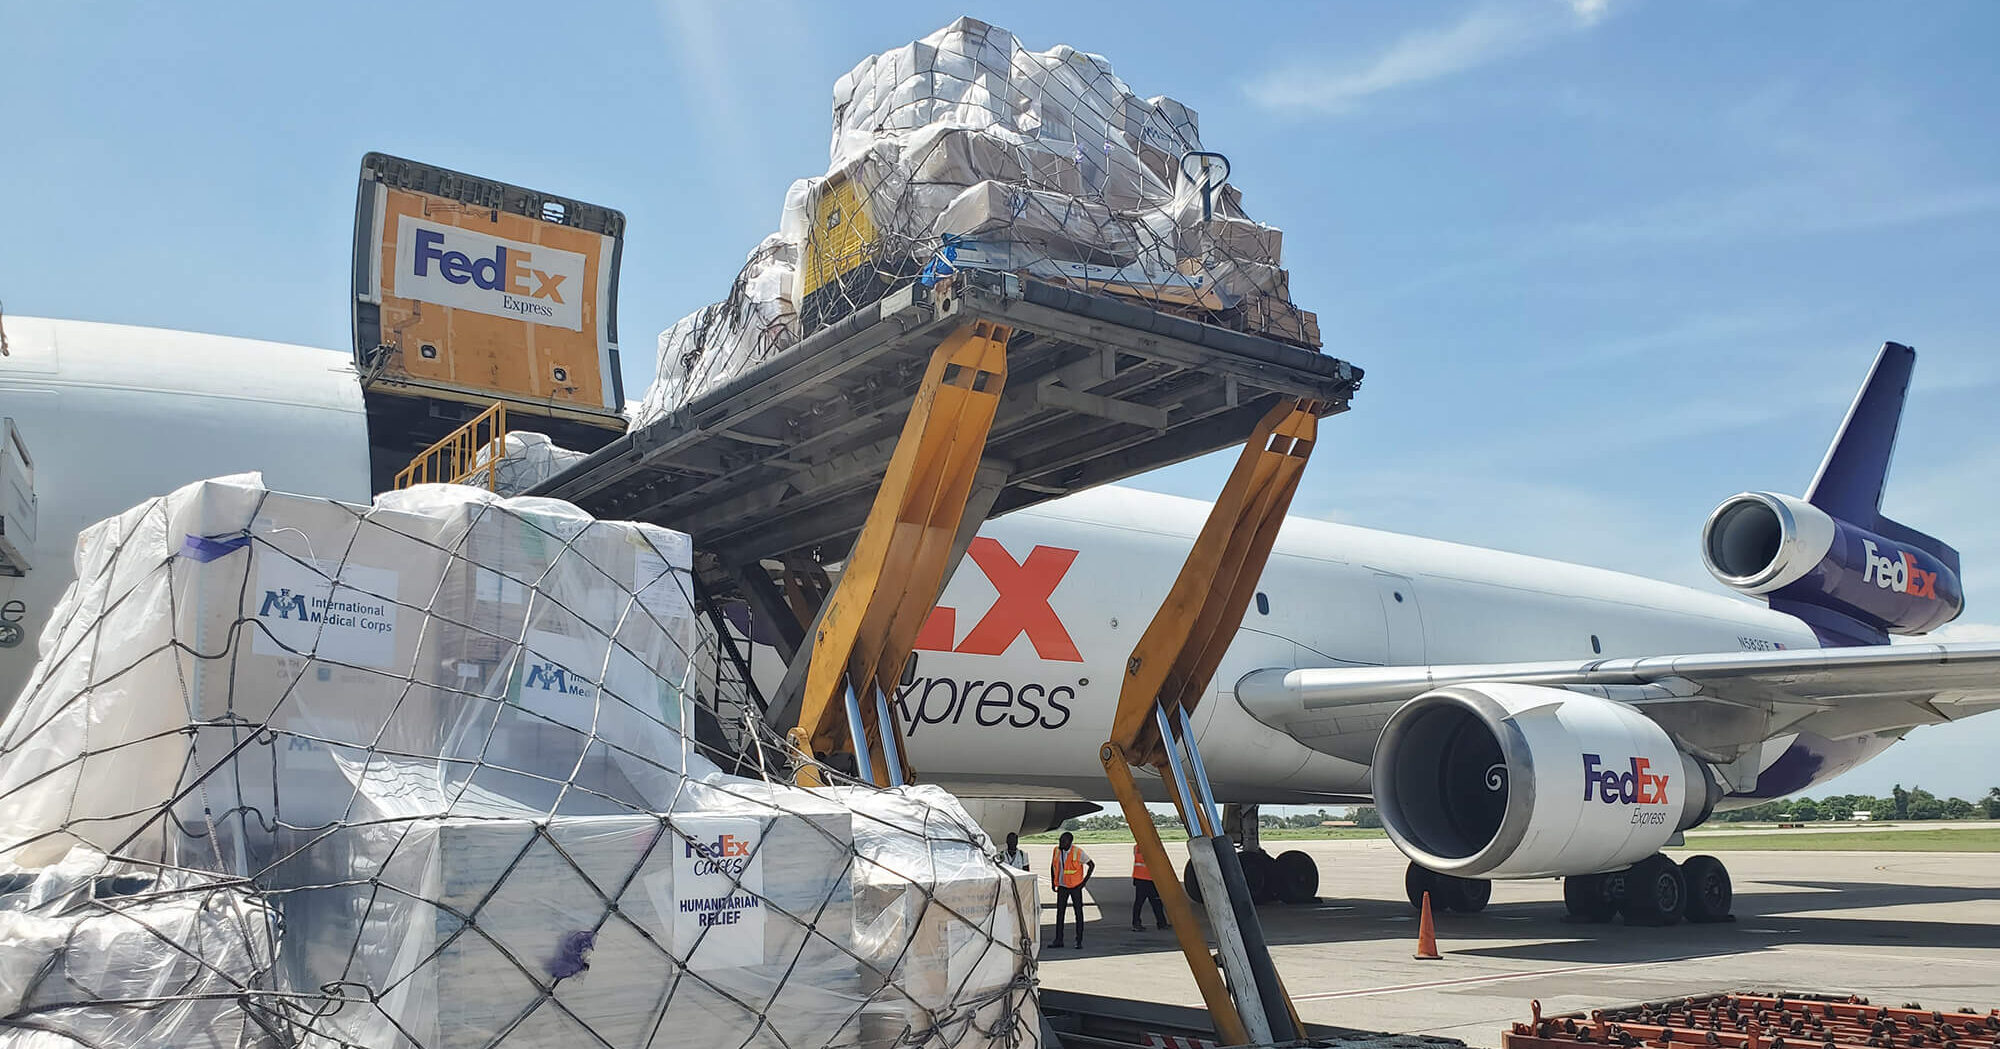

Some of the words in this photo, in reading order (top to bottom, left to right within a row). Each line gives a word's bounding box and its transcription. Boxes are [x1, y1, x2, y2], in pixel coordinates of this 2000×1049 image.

[414, 228, 567, 304] FedEx
[503, 295, 553, 317] Express
[1862, 538, 1937, 600] FedEx
[311, 596, 385, 617] International
[310, 611, 356, 628] Medical
[360, 618, 393, 633] Corps
[895, 677, 1075, 737] xpress
[1582, 753, 1669, 805] FedEx
[1631, 807, 1666, 827] Express
[685, 835, 750, 858] FedEx
[694, 858, 743, 876] cares
[680, 896, 759, 912] HUMANITARIAN
[699, 911, 741, 926] RELIEF
